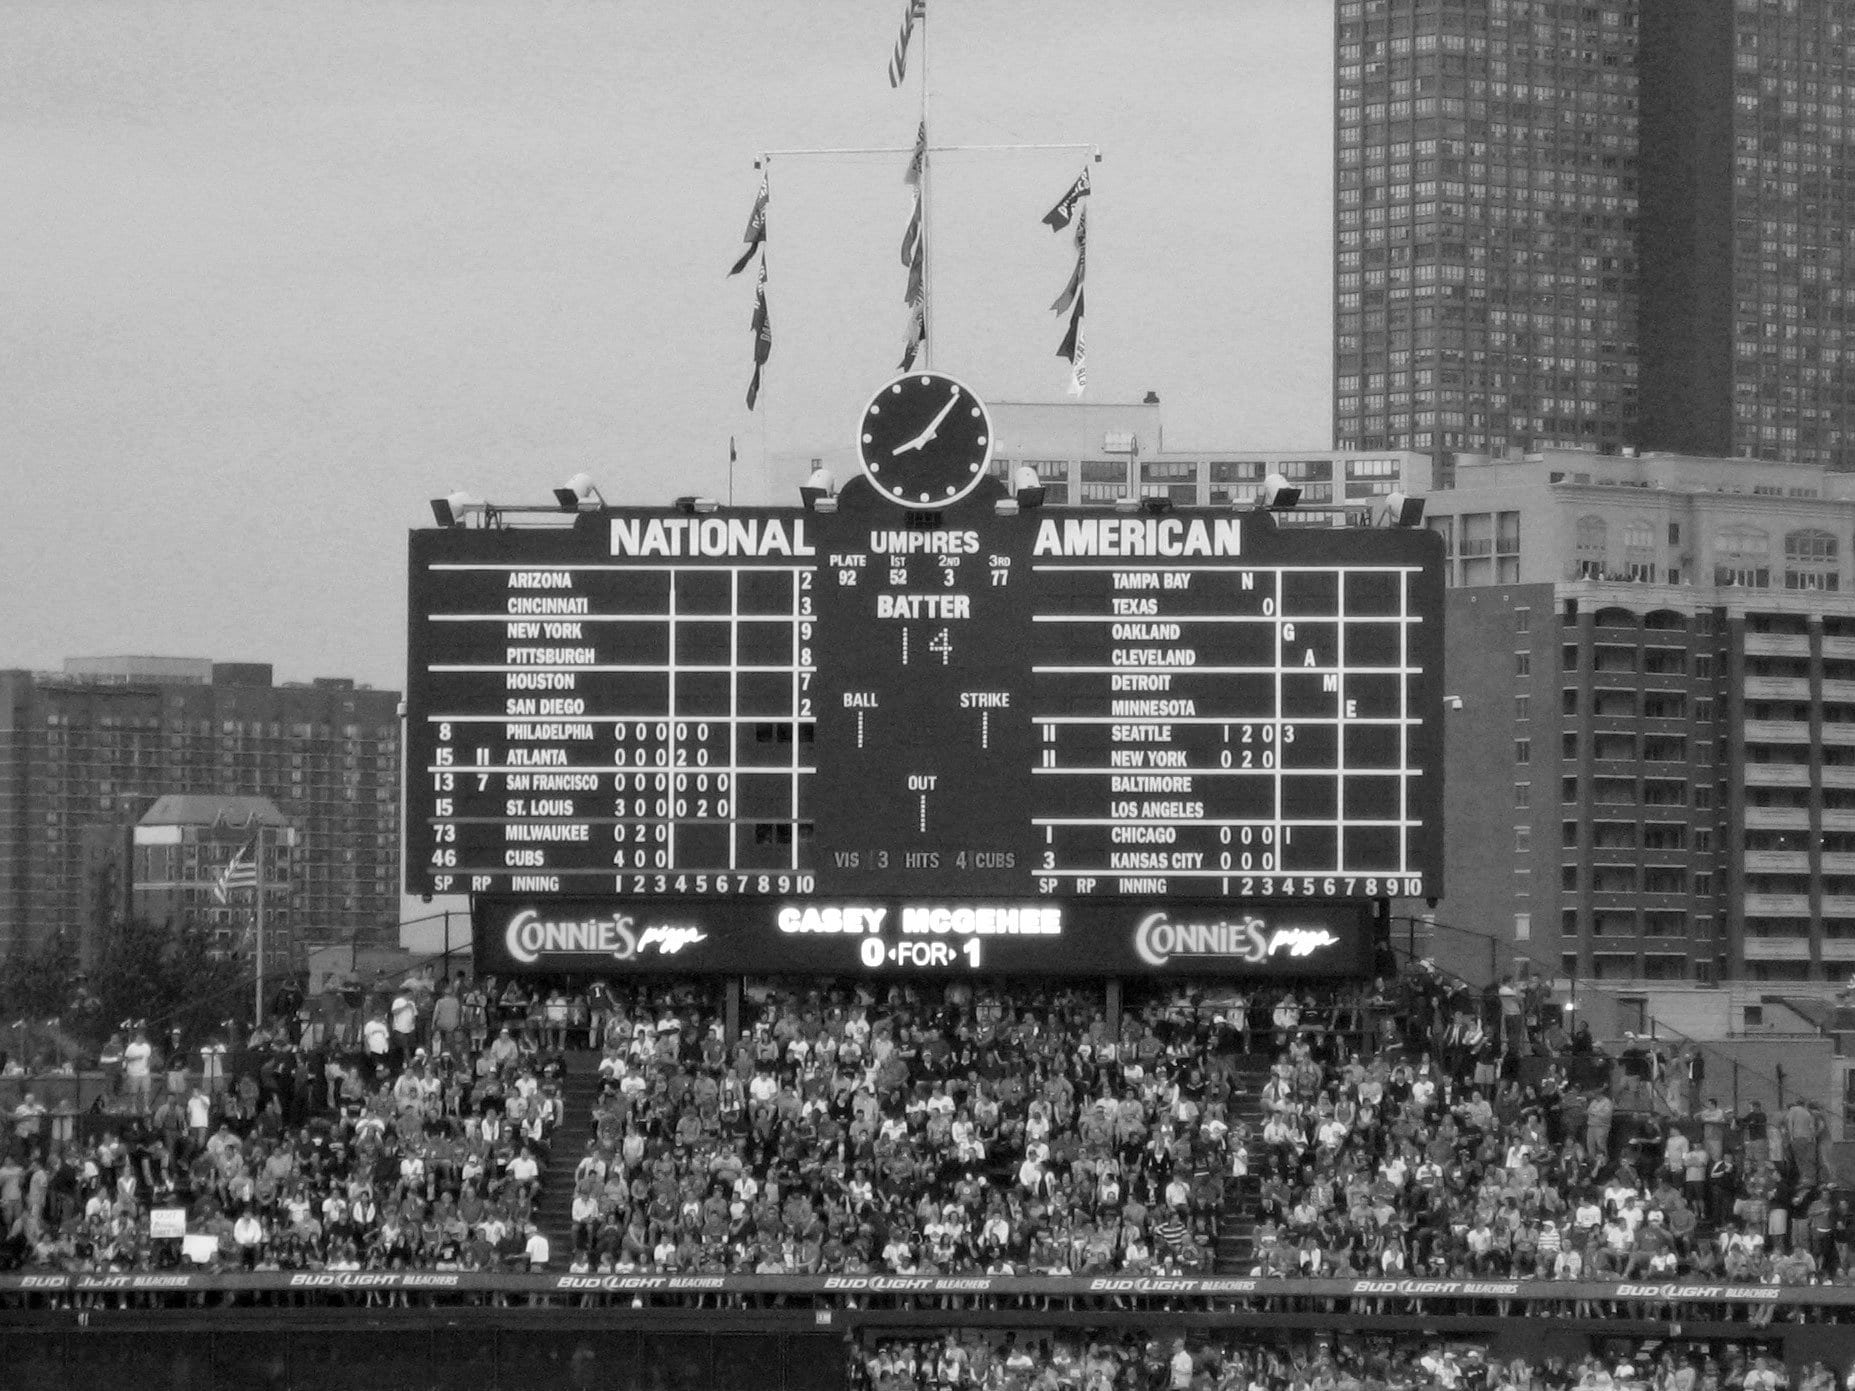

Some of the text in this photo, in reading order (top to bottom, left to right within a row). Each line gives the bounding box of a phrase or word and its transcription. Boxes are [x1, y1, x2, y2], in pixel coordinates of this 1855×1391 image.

[611, 519, 815, 556] NATIONAL
[871, 531, 979, 553] UMPIRES
[1033, 519, 1240, 556] AMERICAN
[830, 555, 866, 566] PLATE
[939, 555, 960, 566] 2ND
[989, 555, 1010, 566] 3RD
[508, 572, 572, 588] ARIZONA
[802, 572, 811, 589] 2
[839, 569, 1008, 586] 92 52 3 77
[1113, 573, 1191, 589] TAMPA BAY
[508, 598, 587, 613] CINCINNATI
[800, 597, 813, 616] 3
[878, 595, 970, 618] BATTER
[1112, 599, 1157, 615] TEXAS
[508, 623, 582, 639] NEW YORK
[801, 623, 811, 640] 9
[1112, 624, 1180, 639] OAKLAND
[507, 648, 594, 664] PITTSBURGH
[800, 648, 813, 666] 8
[1112, 649, 1195, 665] CLEVELAND
[507, 673, 574, 689] HOUSTON
[801, 673, 811, 690] 7
[1112, 675, 1171, 690] DETROIT
[507, 699, 584, 715] SAN DIEGO
[800, 699, 813, 717] 2
[844, 693, 878, 707] BALL
[961, 693, 1009, 707] STRIKE
[1112, 700, 1195, 716] MINNESOTA
[440, 723, 708, 741] 8 PHILADELPHIA 0 0 0 0
[1112, 725, 1171, 741] SEATTLE
[1242, 725, 1252, 742] 2
[1284, 725, 1294, 743] 3
[435, 748, 454, 767] 15
[507, 749, 567, 765] ATLANTA
[614, 748, 626, 767] 0
[634, 748, 647, 767] 0
[676, 749, 687, 767] 2
[696, 749, 709, 767] 0
[1112, 751, 1144, 766] NEW
[1147, 751, 1187, 767] YORK
[1221, 750, 1231, 768] 0
[1242, 751, 1252, 768] 2
[435, 773, 707, 791] 13 7 SAN FRANCISCO 0 0 0 0
[908, 775, 937, 790] OUT
[1112, 776, 1191, 792] BALTIMORE
[436, 799, 707, 817] 15 ST. LOUIS 3 0 0 2
[1112, 802, 1203, 818] LOS ANGELES
[434, 824, 645, 842] 73 MILWAUKEE 0 2
[1112, 826, 1231, 844] CHICAGO 0
[432, 849, 645, 867] 46 CUBS 4 0
[835, 851, 1015, 869] VIS 3 HITS 4 CUBS
[1042, 851, 1231, 870] 3 KANSAS CITY 0
[435, 875, 814, 893] SP RP INNING 2 3 4 5 6 7 8 9 10
[1040, 877, 1421, 895] SP RP INNING 2 3 4 5 6 7 8 9 10
[778, 908, 1061, 933] CASEY MCGEHEE
[861, 937, 980, 967] 0 FOR 1
[290, 1274, 335, 1286] BUD
[344, 1275, 400, 1285] LIGHT
[557, 1276, 601, 1288] BUD
[610, 1278, 666, 1288] LIGHT
[824, 1277, 868, 1289] BUD
[877, 1279, 933, 1289] LIGHT
[1090, 1279, 1133, 1290] BUD
[1141, 1281, 1199, 1291] LIGHT
[1353, 1282, 1398, 1293] BUD
[1406, 1283, 1462, 1293] LIGHT
[1616, 1285, 1659, 1296] BUD
[1668, 1286, 1724, 1297] LIGHT
